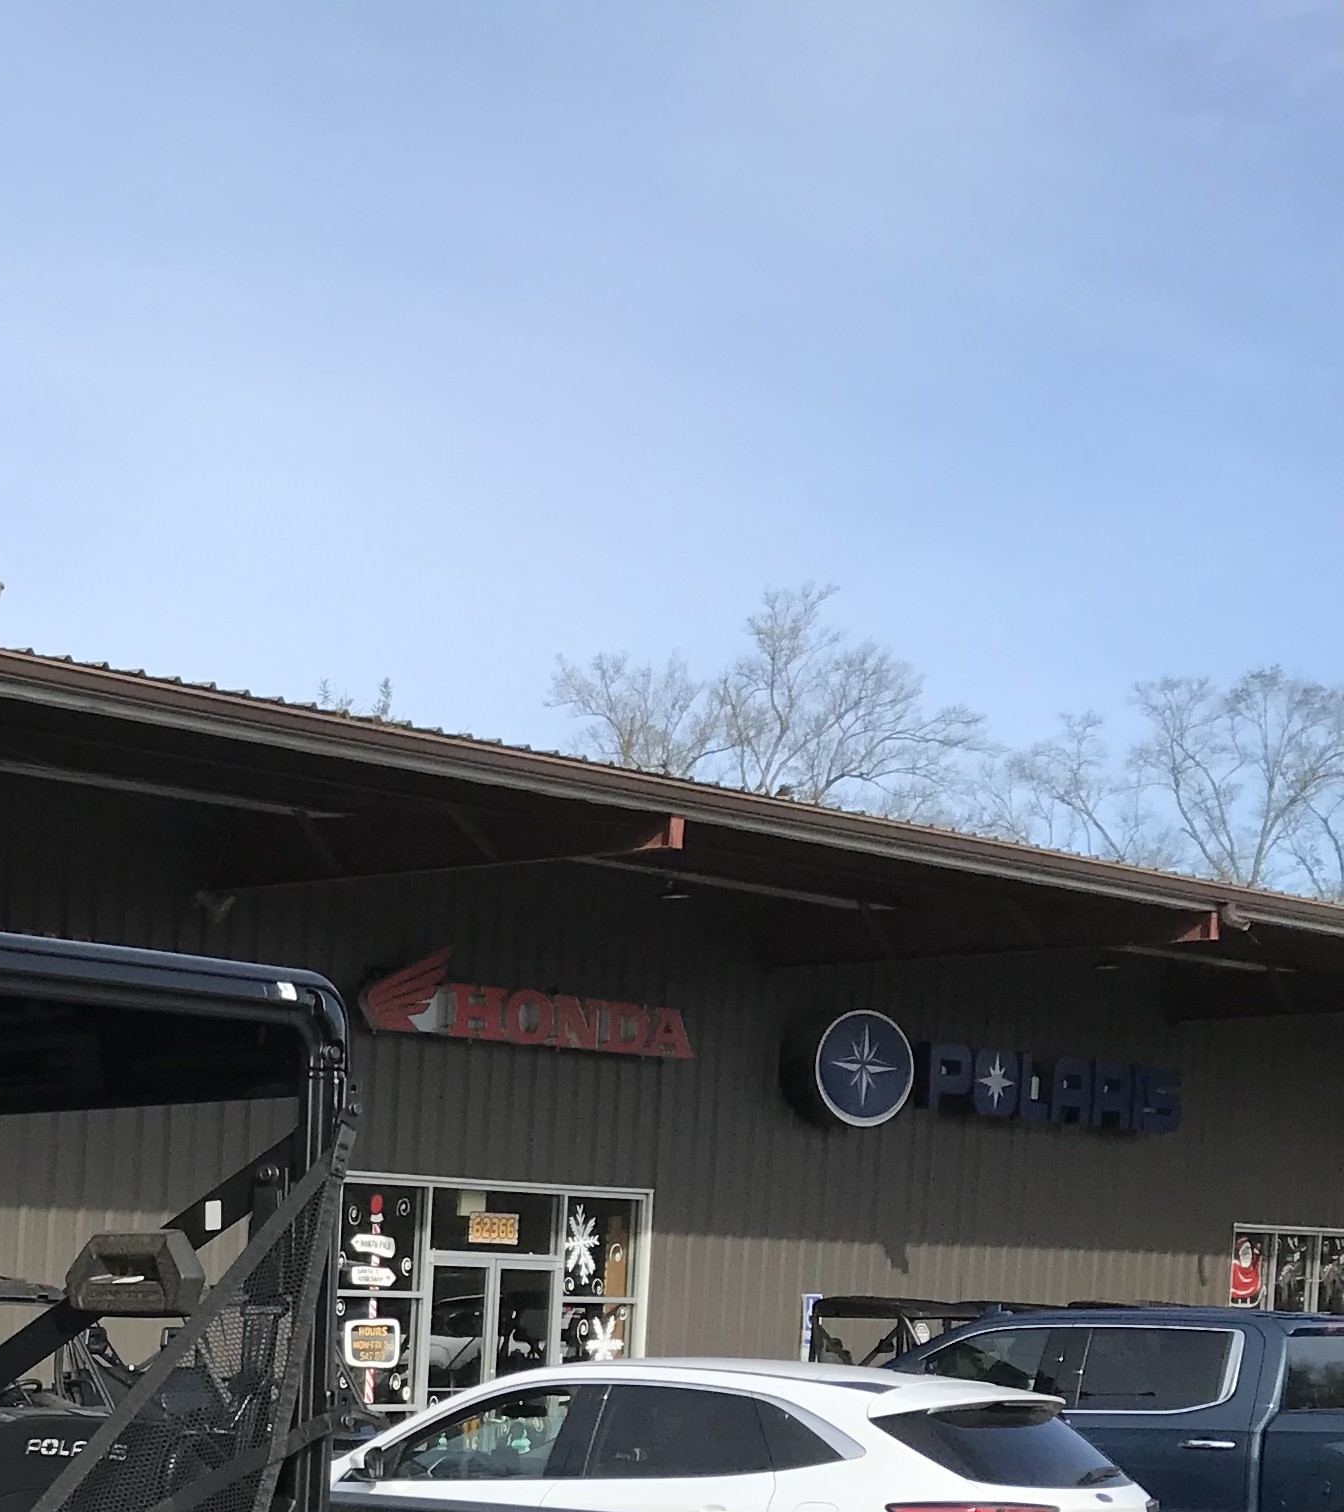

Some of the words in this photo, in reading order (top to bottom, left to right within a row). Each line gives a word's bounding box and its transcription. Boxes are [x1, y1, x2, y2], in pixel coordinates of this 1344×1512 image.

[447, 983, 694, 1059] HONDA
[929, 1041, 1182, 1134] POLARIS
[472, 1216, 517, 1240] 62366
[358, 1326, 388, 1337] HOURS
[25, 1438, 128, 1461] POLAS
